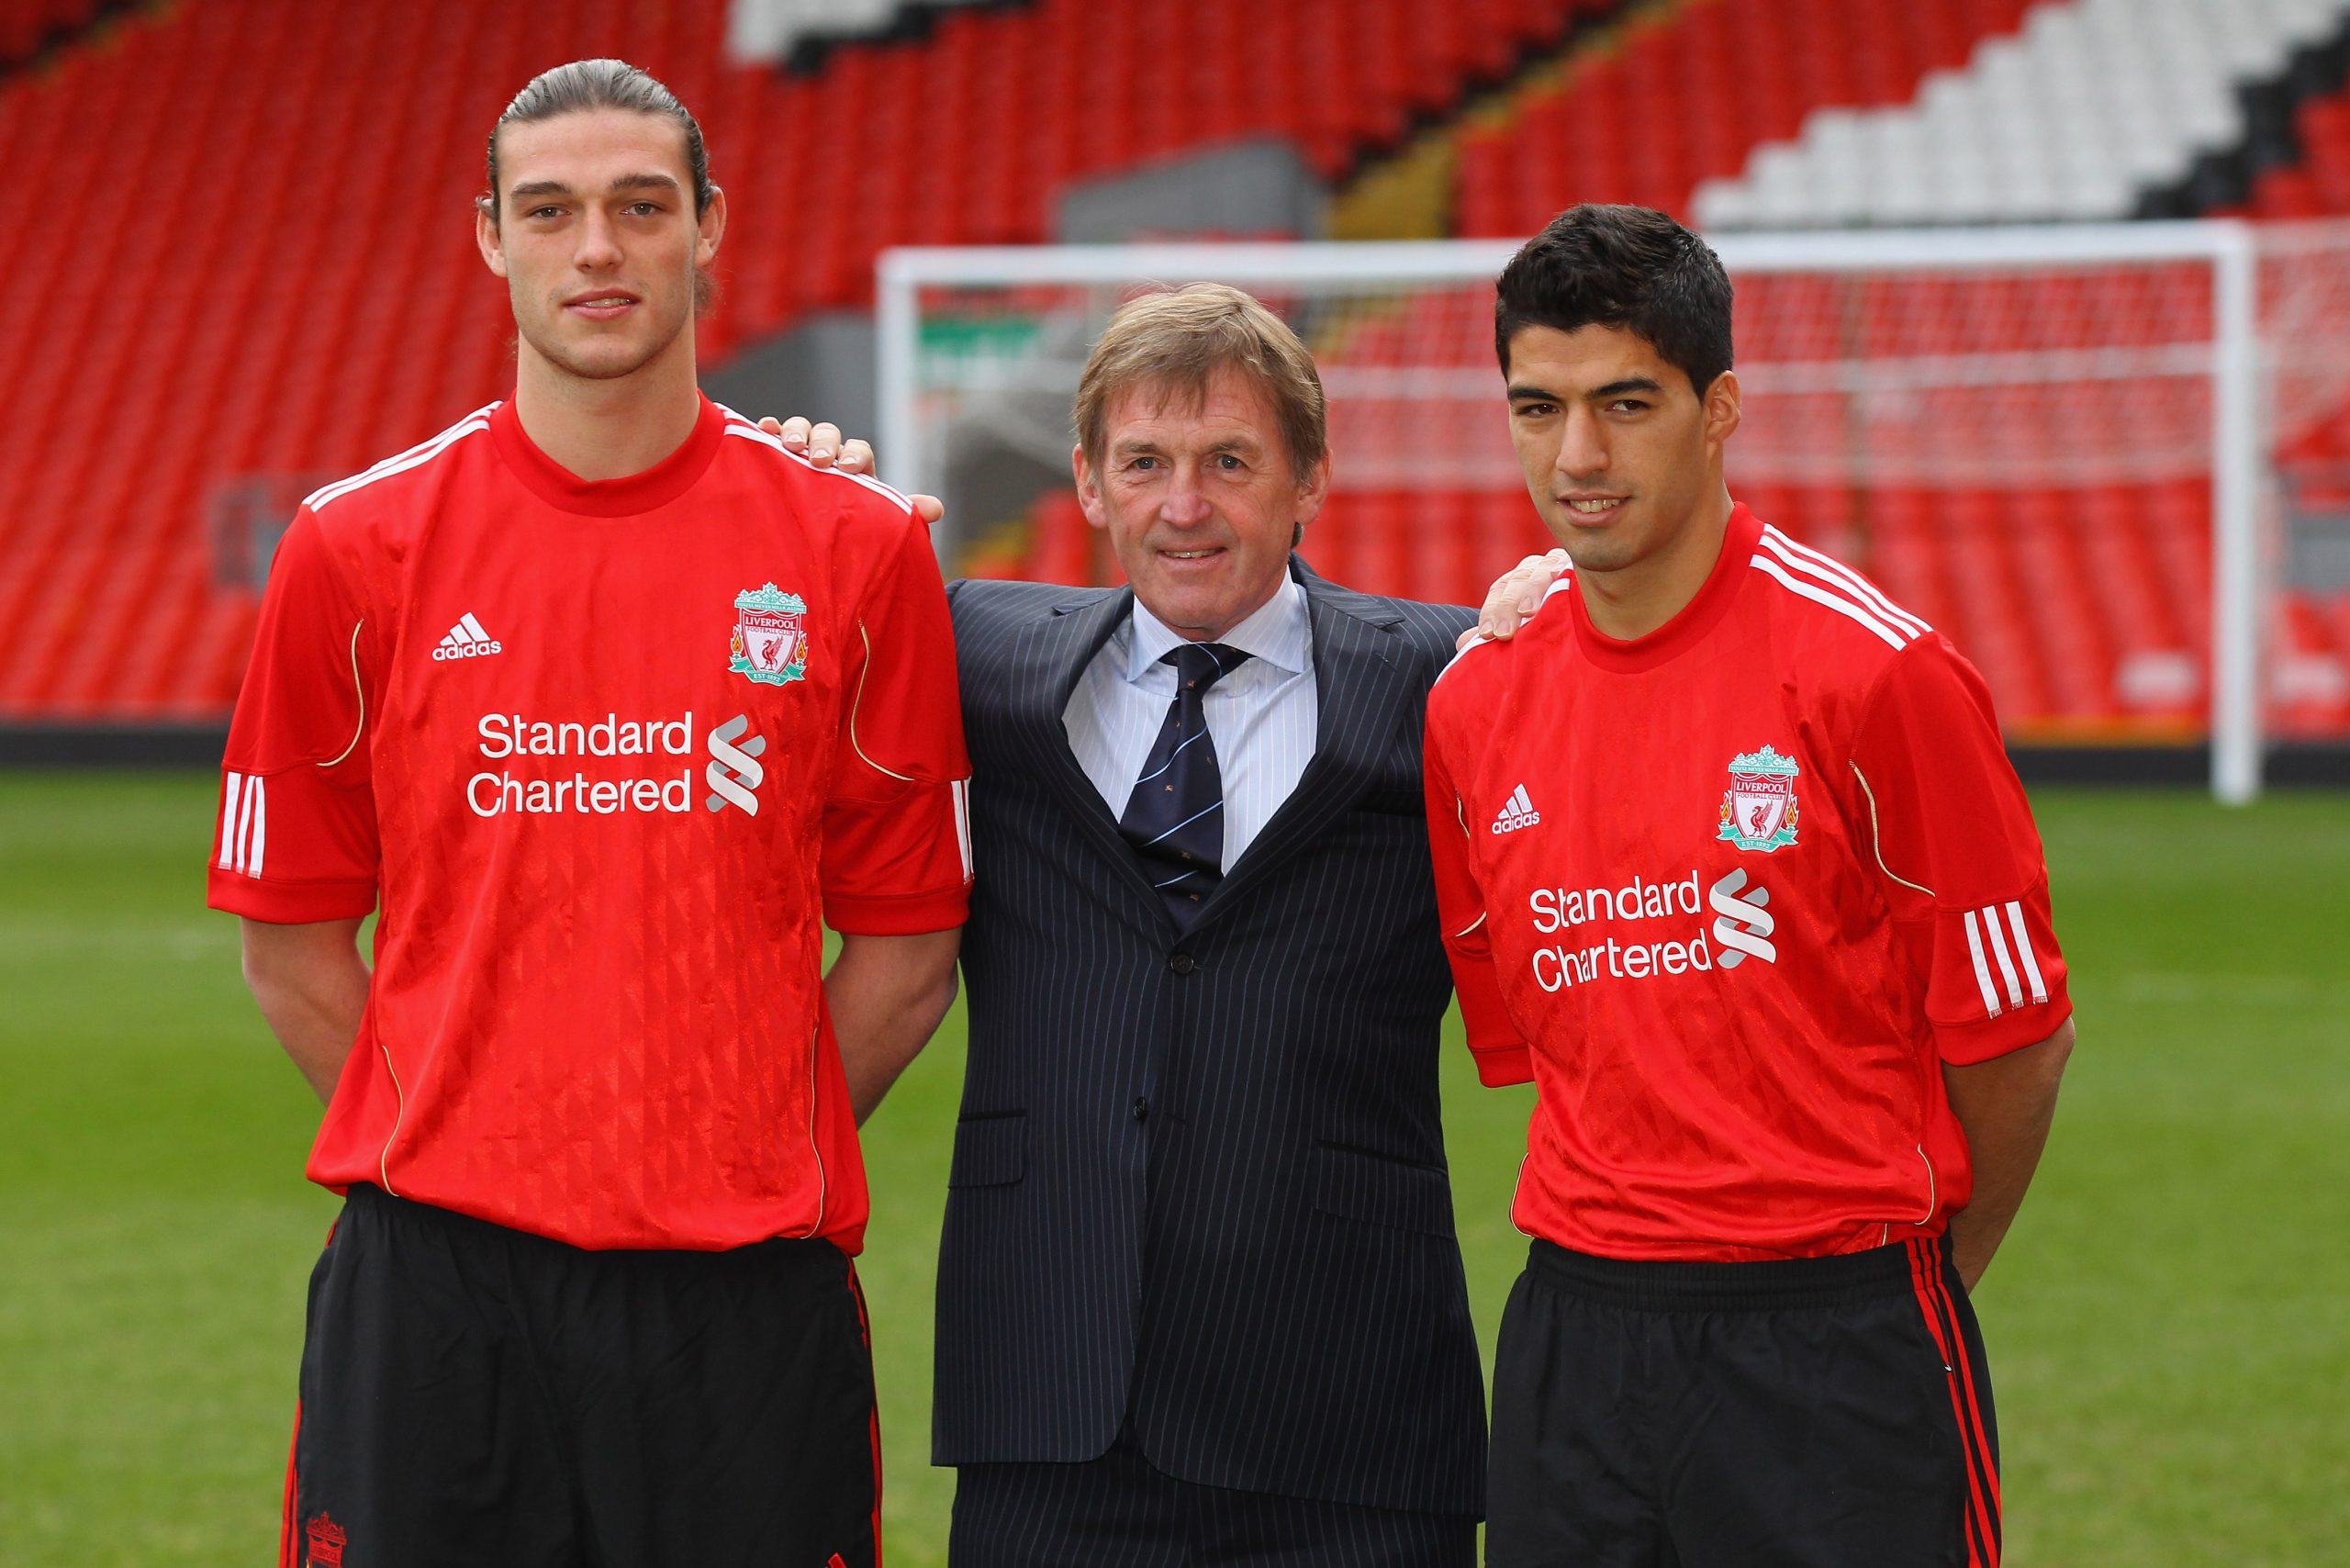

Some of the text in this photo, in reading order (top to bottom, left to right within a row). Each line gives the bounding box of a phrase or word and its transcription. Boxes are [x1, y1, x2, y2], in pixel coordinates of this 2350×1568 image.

[745, 617, 795, 629] LIVERPOOL
[431, 641, 502, 661] adidas
[477, 711, 693, 759] Standard
[466, 768, 691, 818] Chartered
[1737, 781, 1785, 792] LIVERPOOL
[1492, 812, 1540, 834] adidas
[1529, 869, 1702, 934] Standard
[1531, 928, 1713, 993] Chartered
